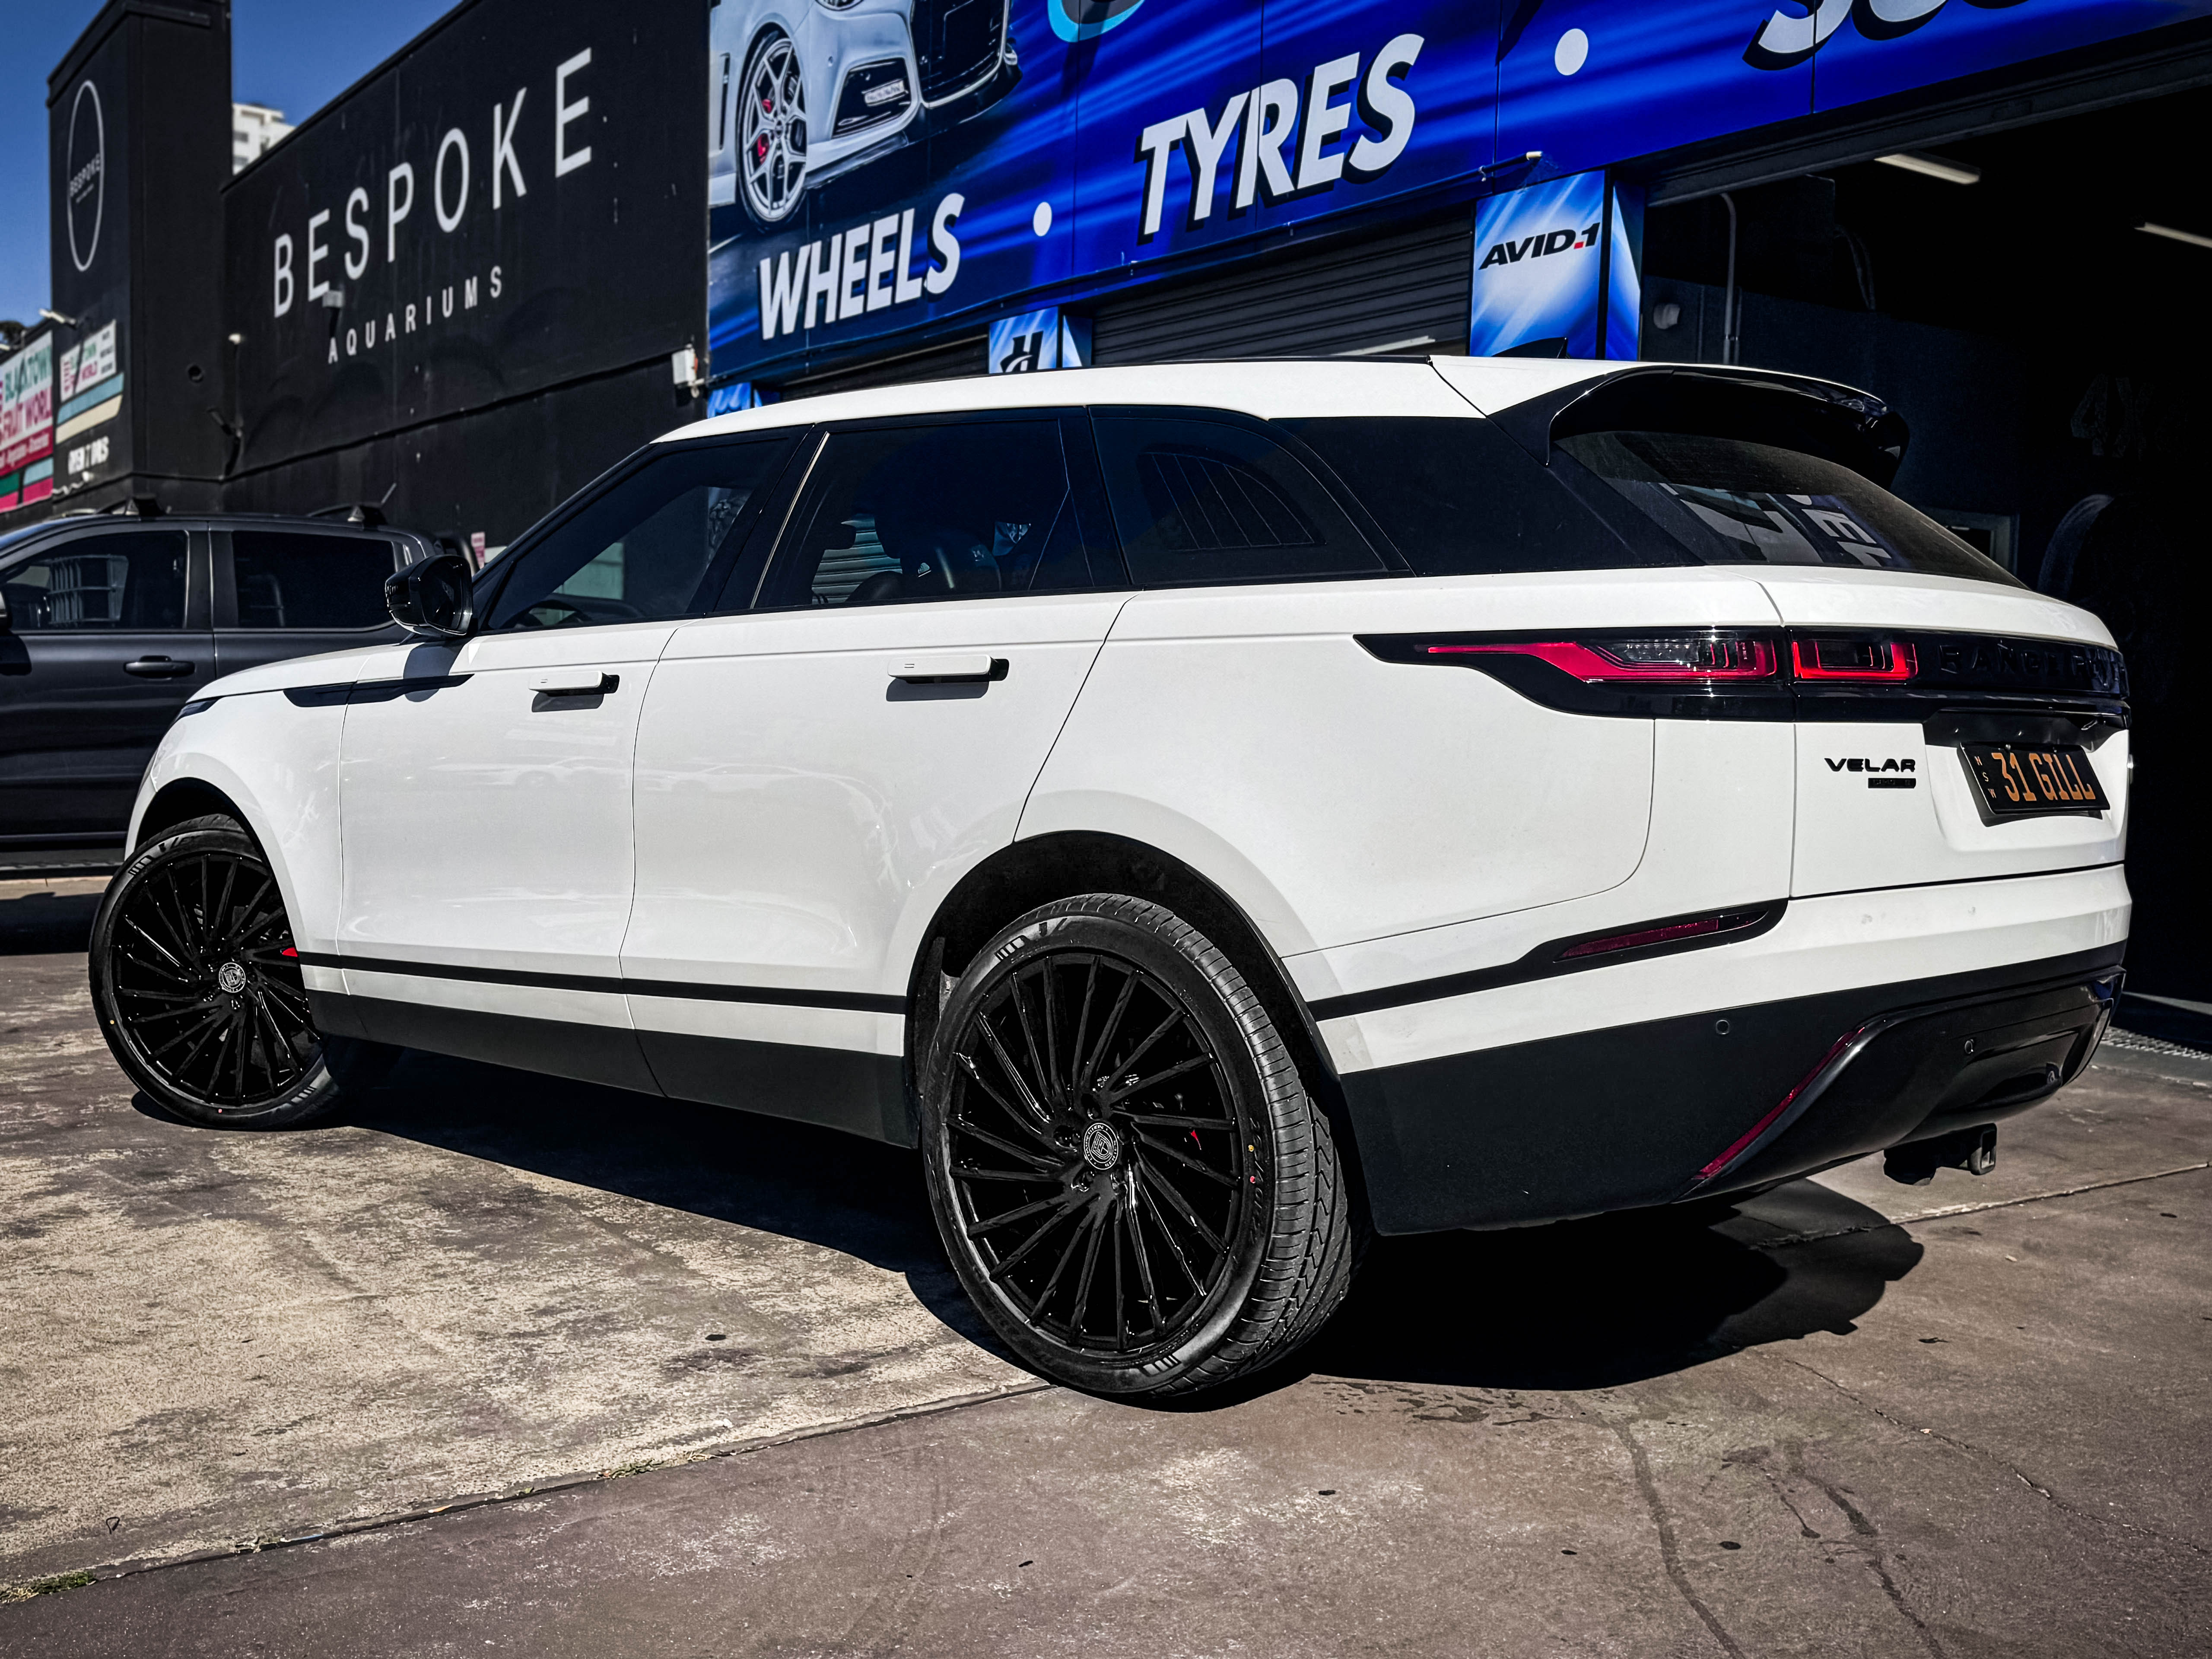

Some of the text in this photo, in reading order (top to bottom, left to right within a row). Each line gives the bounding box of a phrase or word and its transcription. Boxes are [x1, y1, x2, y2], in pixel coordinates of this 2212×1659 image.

[274, 47, 592, 318] BESPOKE
[1139, 33, 1424, 236] TYRES
[760, 193, 965, 340] WHEELS
[1478, 222, 1600, 270] AVID.1
[327, 266, 502, 364] AQUARIUMS
[1824, 758, 1916, 772] VELAR
[1991, 753, 2096, 801] 31 GILL
